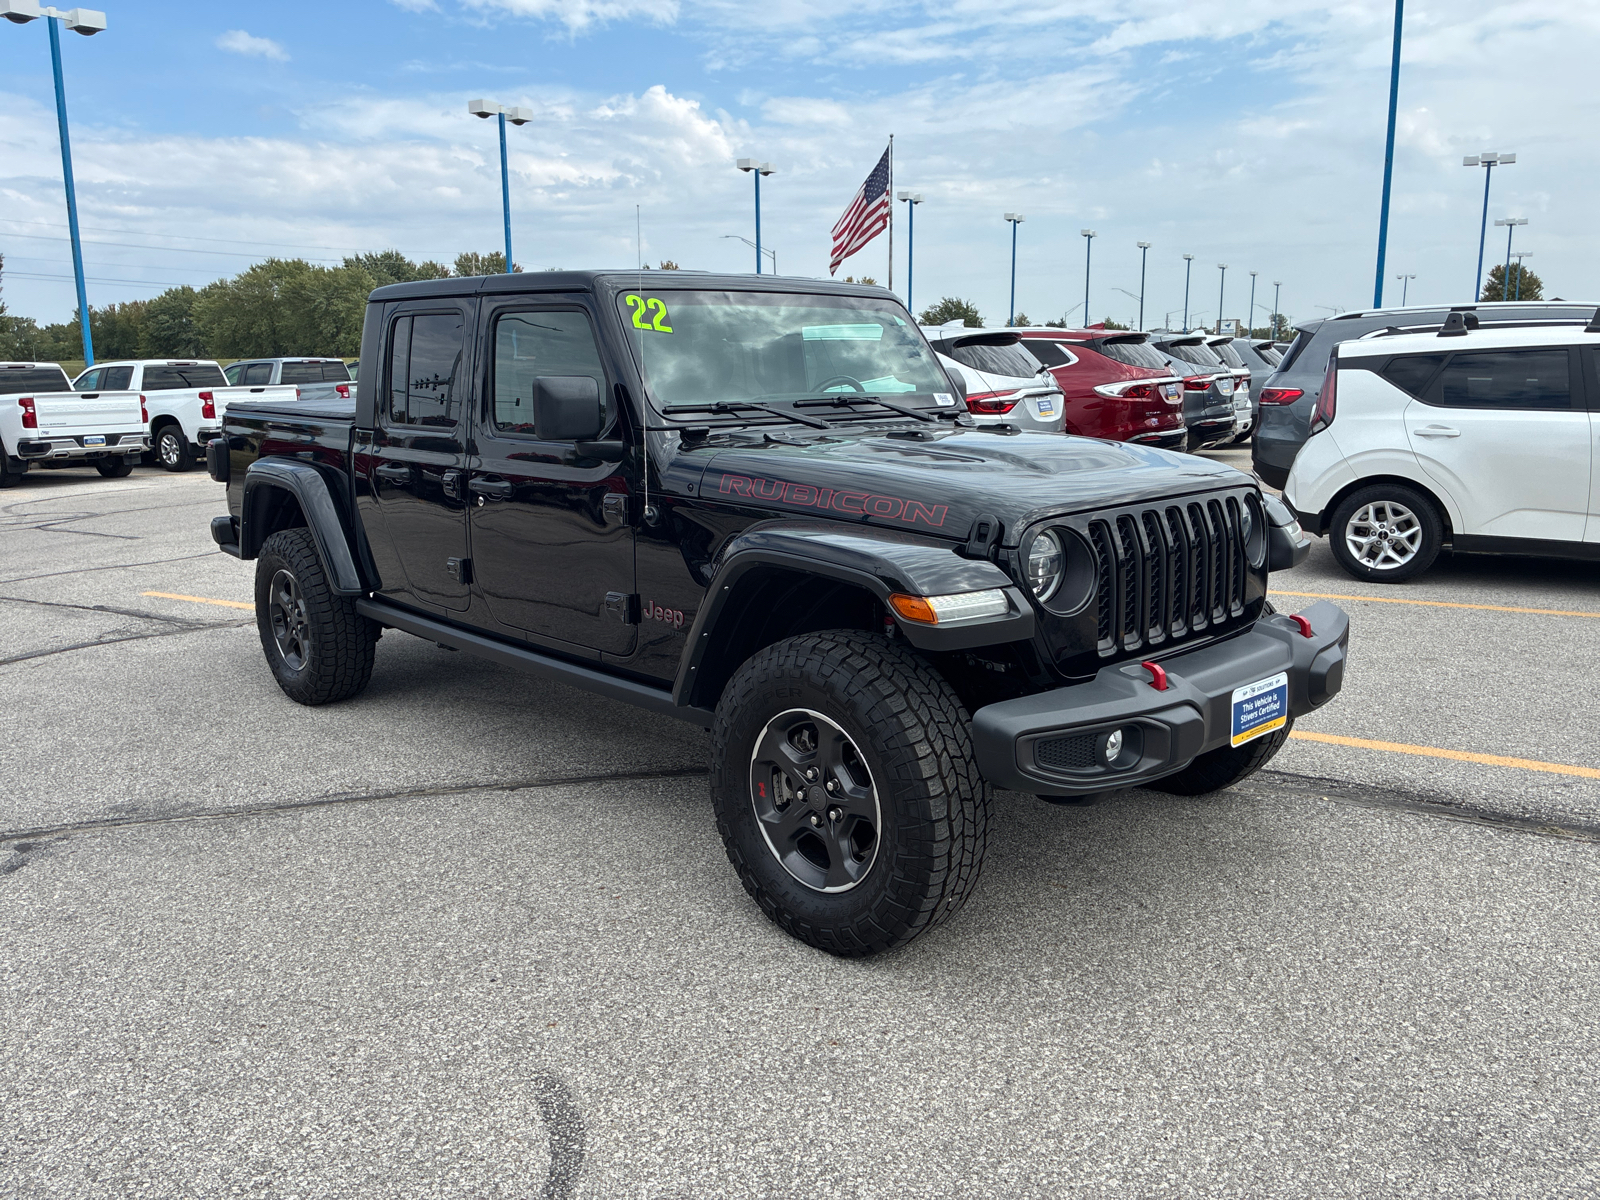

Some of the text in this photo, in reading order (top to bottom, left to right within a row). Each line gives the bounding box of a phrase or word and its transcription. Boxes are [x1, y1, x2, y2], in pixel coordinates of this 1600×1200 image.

[625, 294, 674, 333] 22
[719, 474, 948, 527] RUBICON
[643, 599, 685, 629] Jeep
[1257, 681, 1274, 691] SOLUTIONS
[734, 686, 803, 741] COOPER
[1240, 711, 1258, 723] Stivers
[1258, 700, 1280, 715] Certified
[1243, 692, 1277, 712] This Vehicle is
